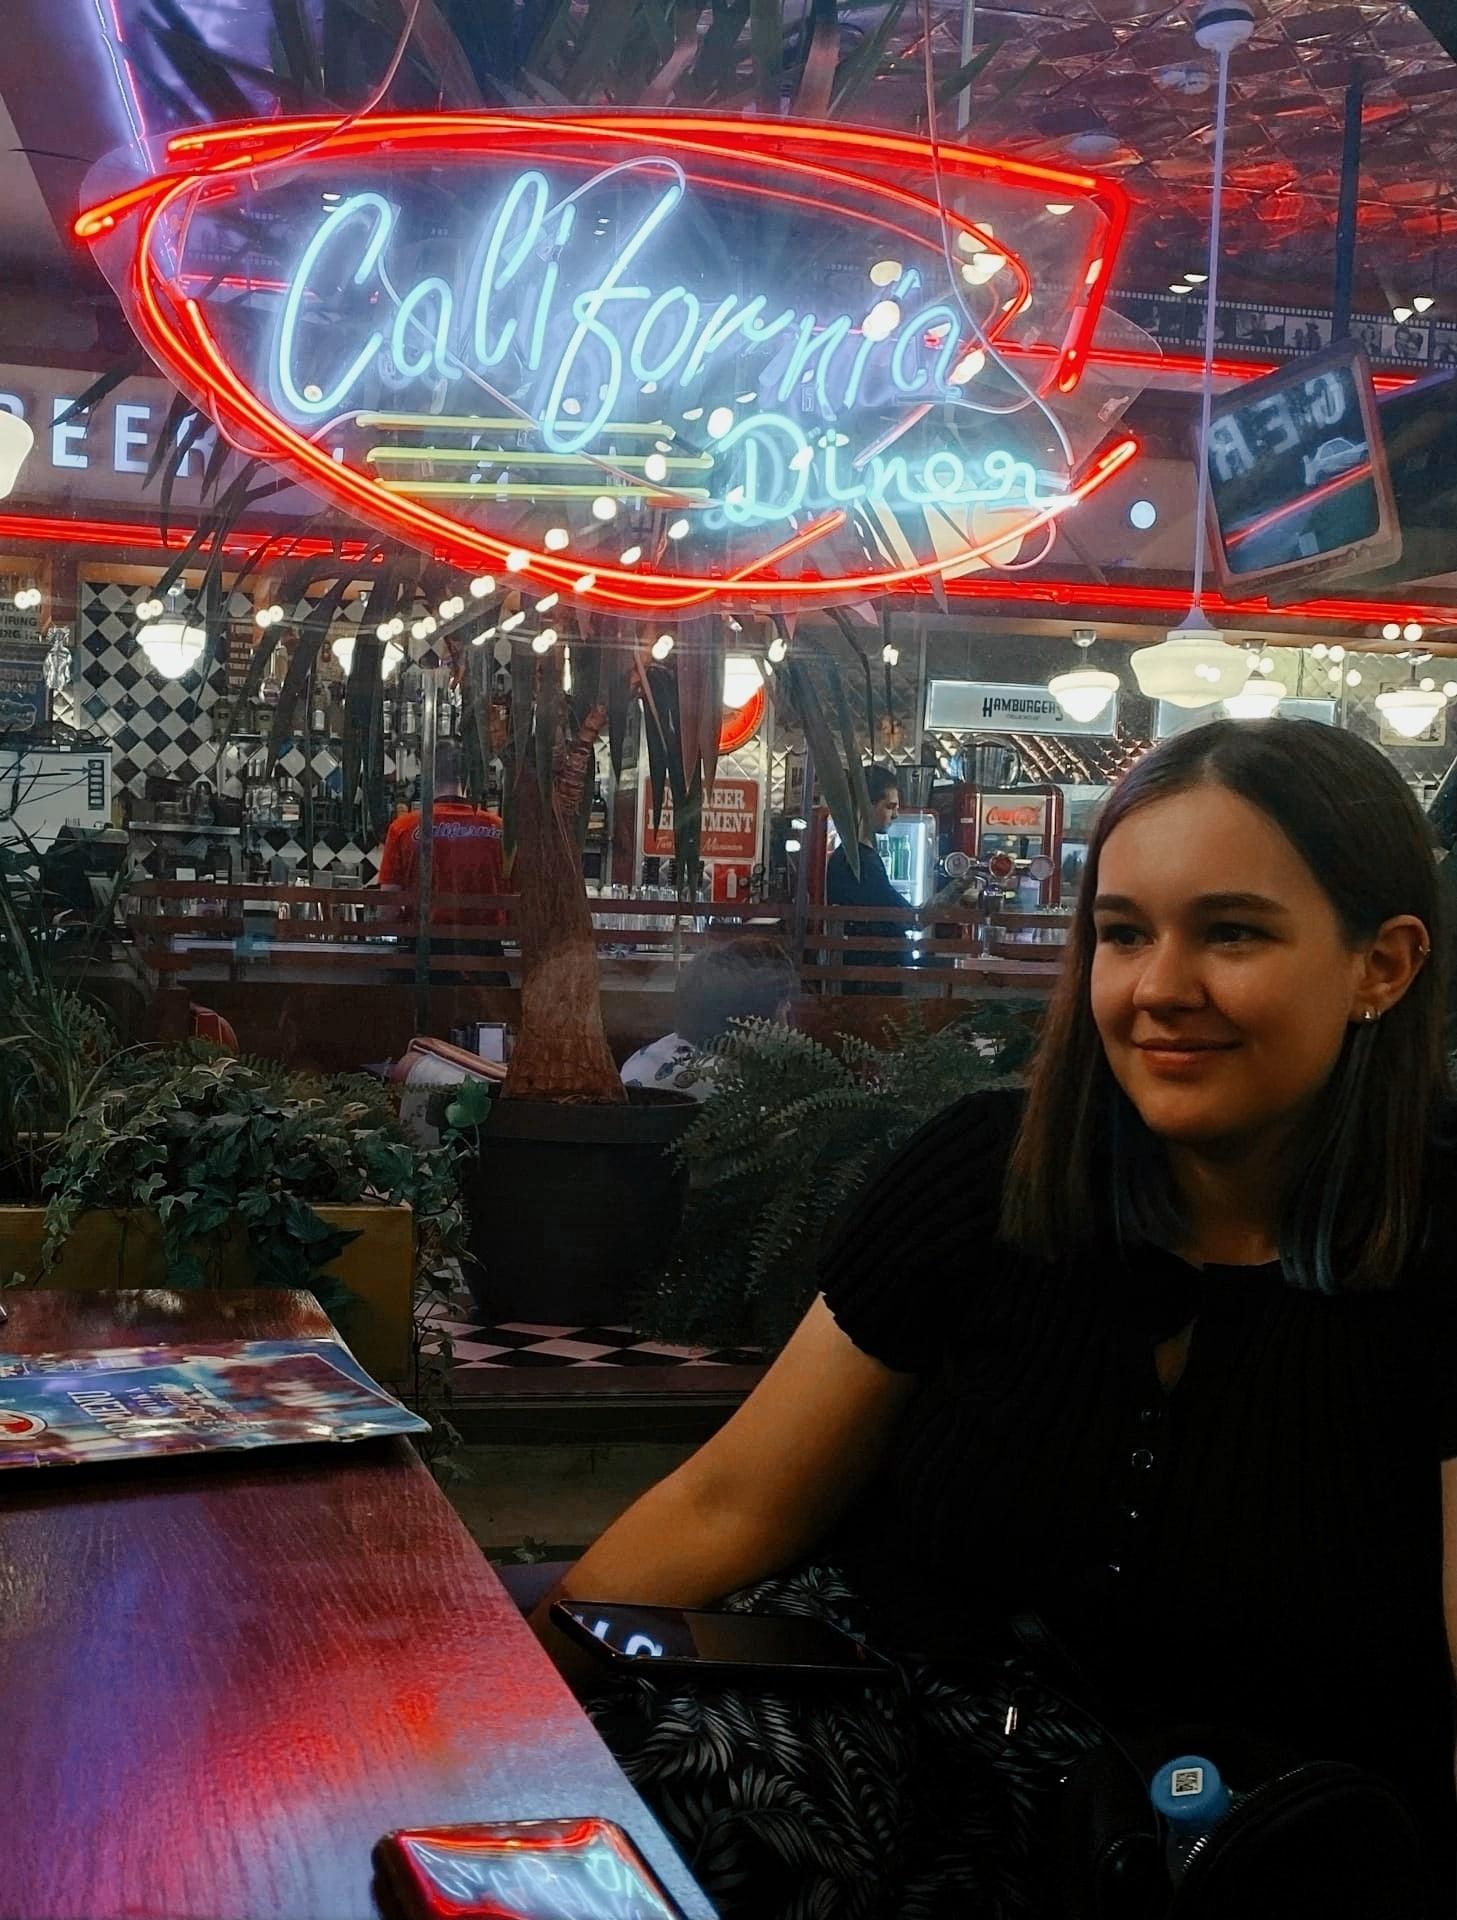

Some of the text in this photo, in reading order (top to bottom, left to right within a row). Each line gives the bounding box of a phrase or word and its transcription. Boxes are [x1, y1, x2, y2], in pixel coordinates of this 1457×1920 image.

[276, 170, 964, 454] California
[0, 391, 217, 478] EER
[716, 412, 1076, 521] Diner
[411, 822, 503, 841] Clifornia
[66, 1391, 138, 1423] MENU
